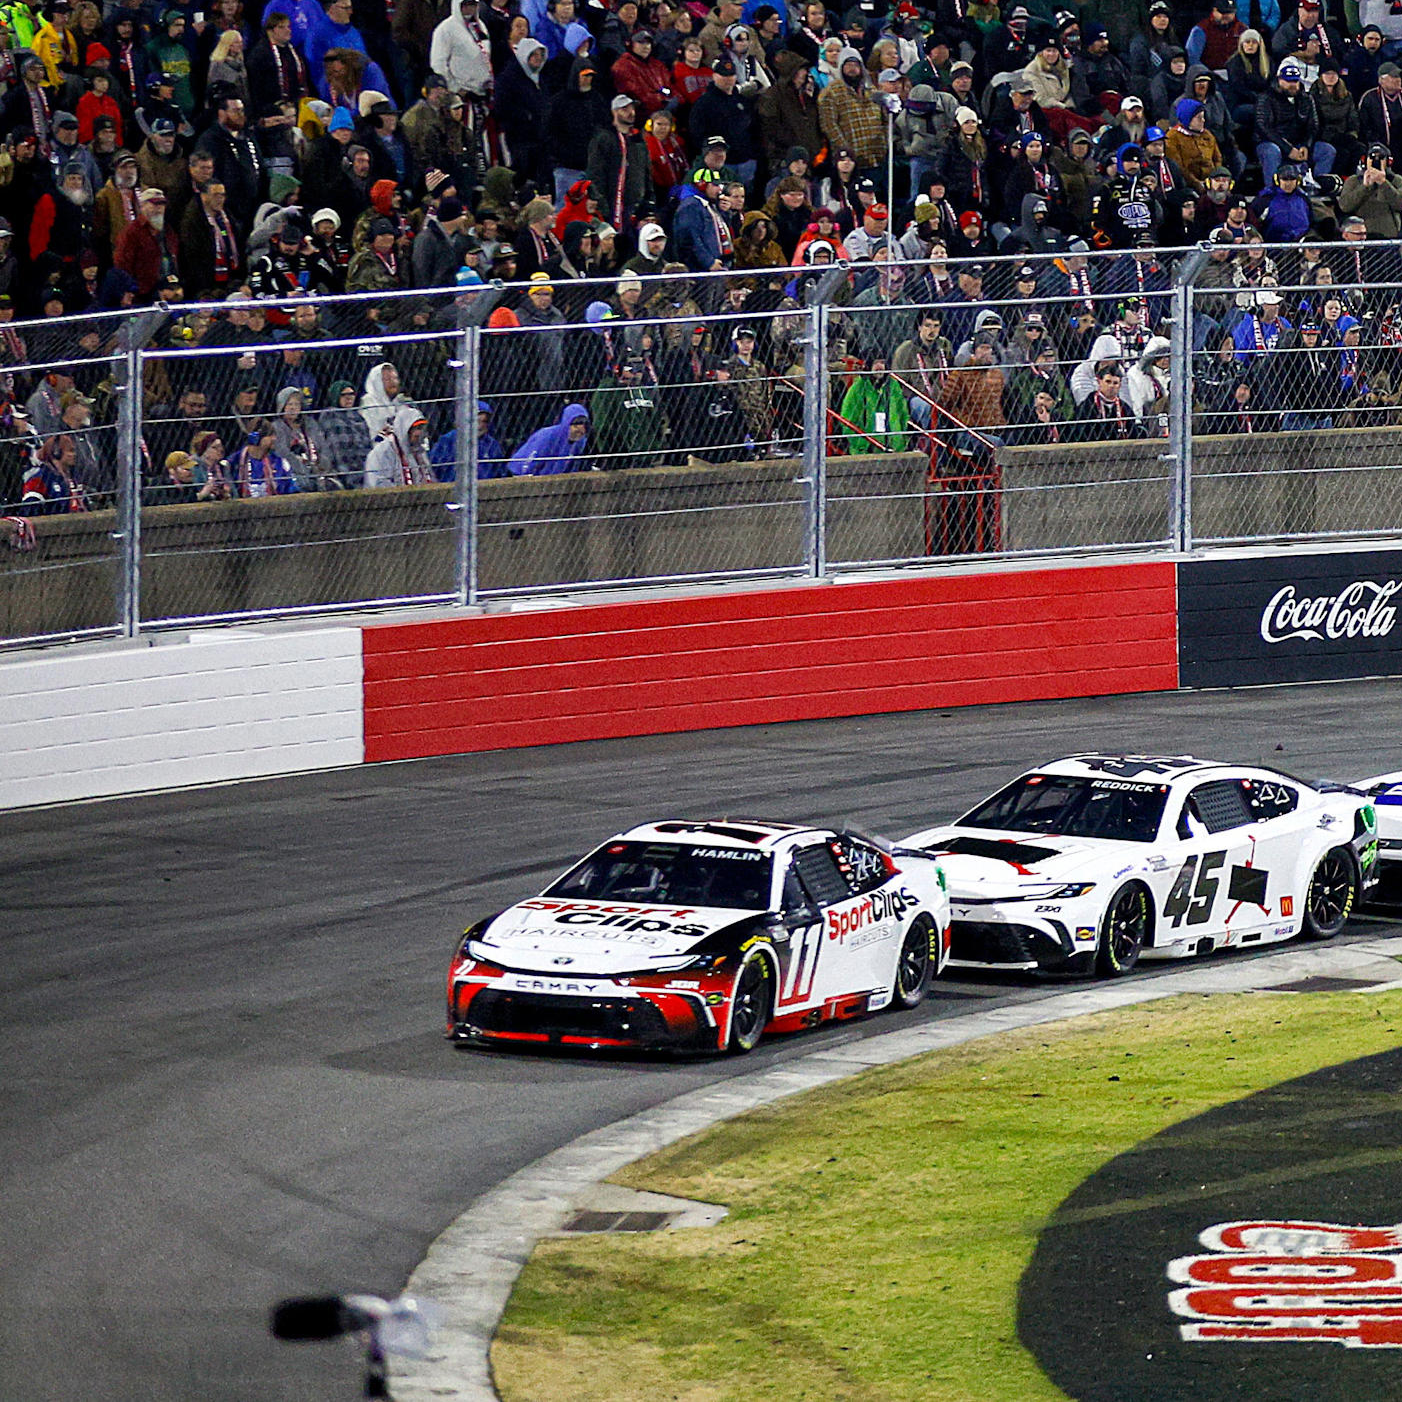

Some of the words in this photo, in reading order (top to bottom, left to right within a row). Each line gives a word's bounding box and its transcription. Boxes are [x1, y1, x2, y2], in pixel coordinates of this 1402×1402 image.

[1091, 780, 1156, 793] REDDICK
[691, 848, 761, 861] HAMLIN
[1163, 850, 1228, 928] 45
[516, 900, 699, 920] Sport
[554, 911, 709, 937] Clips
[508, 926, 659, 945] HAIRCUTS
[779, 922, 824, 1003] 11
[516, 979, 599, 992] CAMRY
